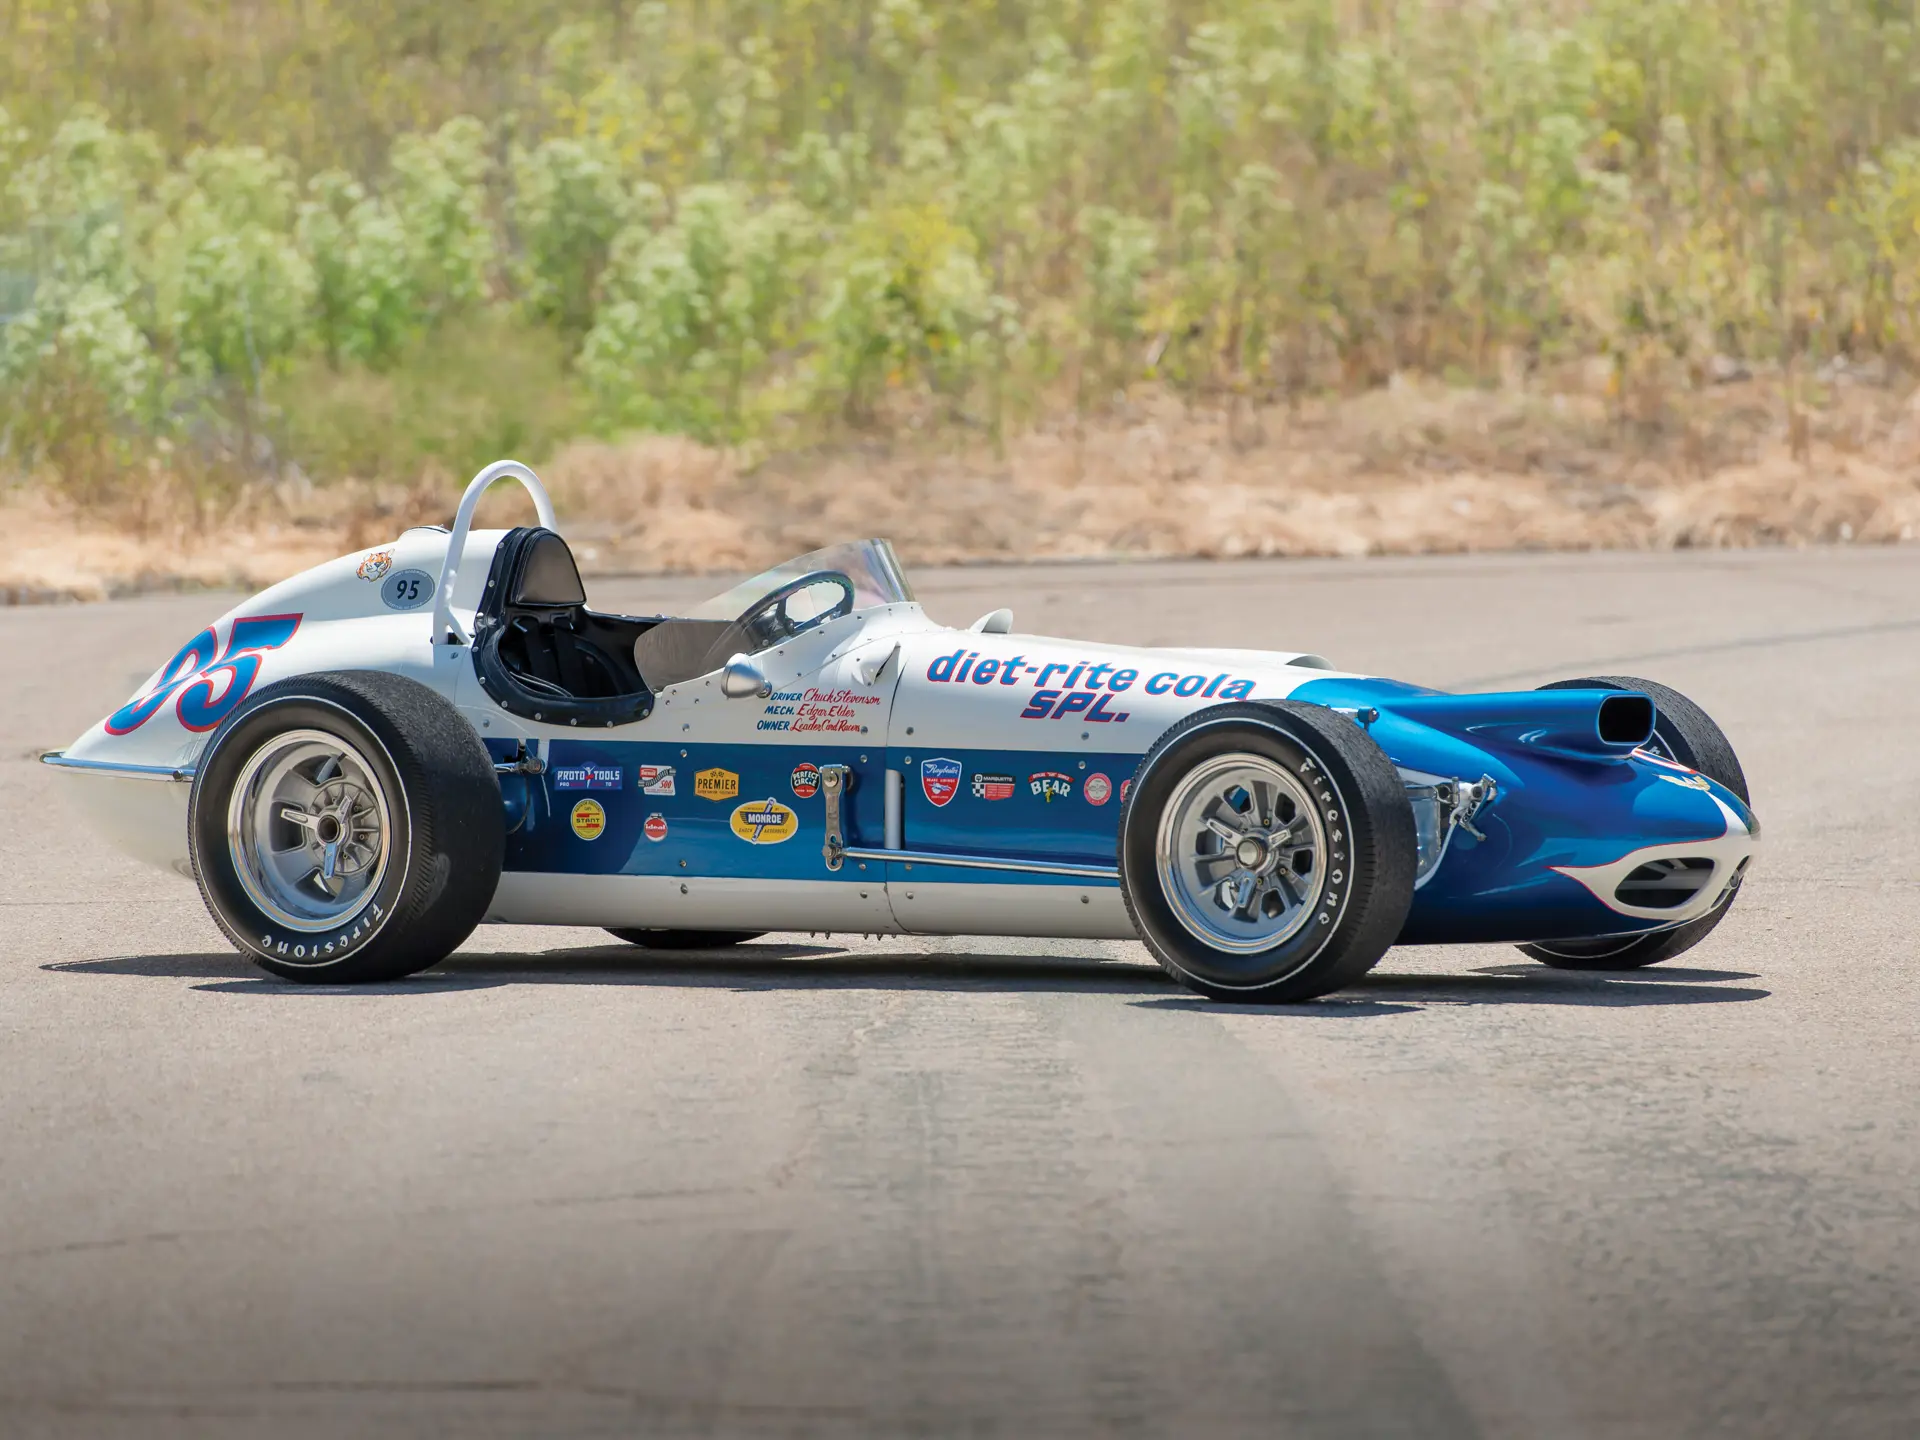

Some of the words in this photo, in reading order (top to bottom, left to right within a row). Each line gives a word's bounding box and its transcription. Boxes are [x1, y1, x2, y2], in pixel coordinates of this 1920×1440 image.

[396, 579, 421, 600] 95
[104, 612, 304, 736] 95
[926, 648, 1139, 692] diet-rite
[1144, 671, 1257, 700] cola
[770, 692, 803, 701] DRIVER
[803, 688, 834, 703] Chuck
[833, 688, 881, 705] Stevenson
[764, 705, 795, 715] MECH.
[796, 703, 827, 720] Edgar
[828, 704, 856, 718] Elder
[1020, 690, 1131, 723] SPL.
[756, 720, 790, 731] OWNER
[557, 770, 585, 780] PROTO
[594, 770, 620, 780] TOOLS
[792, 770, 819, 780] PERFECT
[697, 778, 736, 790] PREMIER
[1030, 779, 1071, 797] BEAR
[748, 813, 782, 824] MONROE
[1300, 757, 1343, 925] Firestone
[261, 902, 384, 958] Firestone
